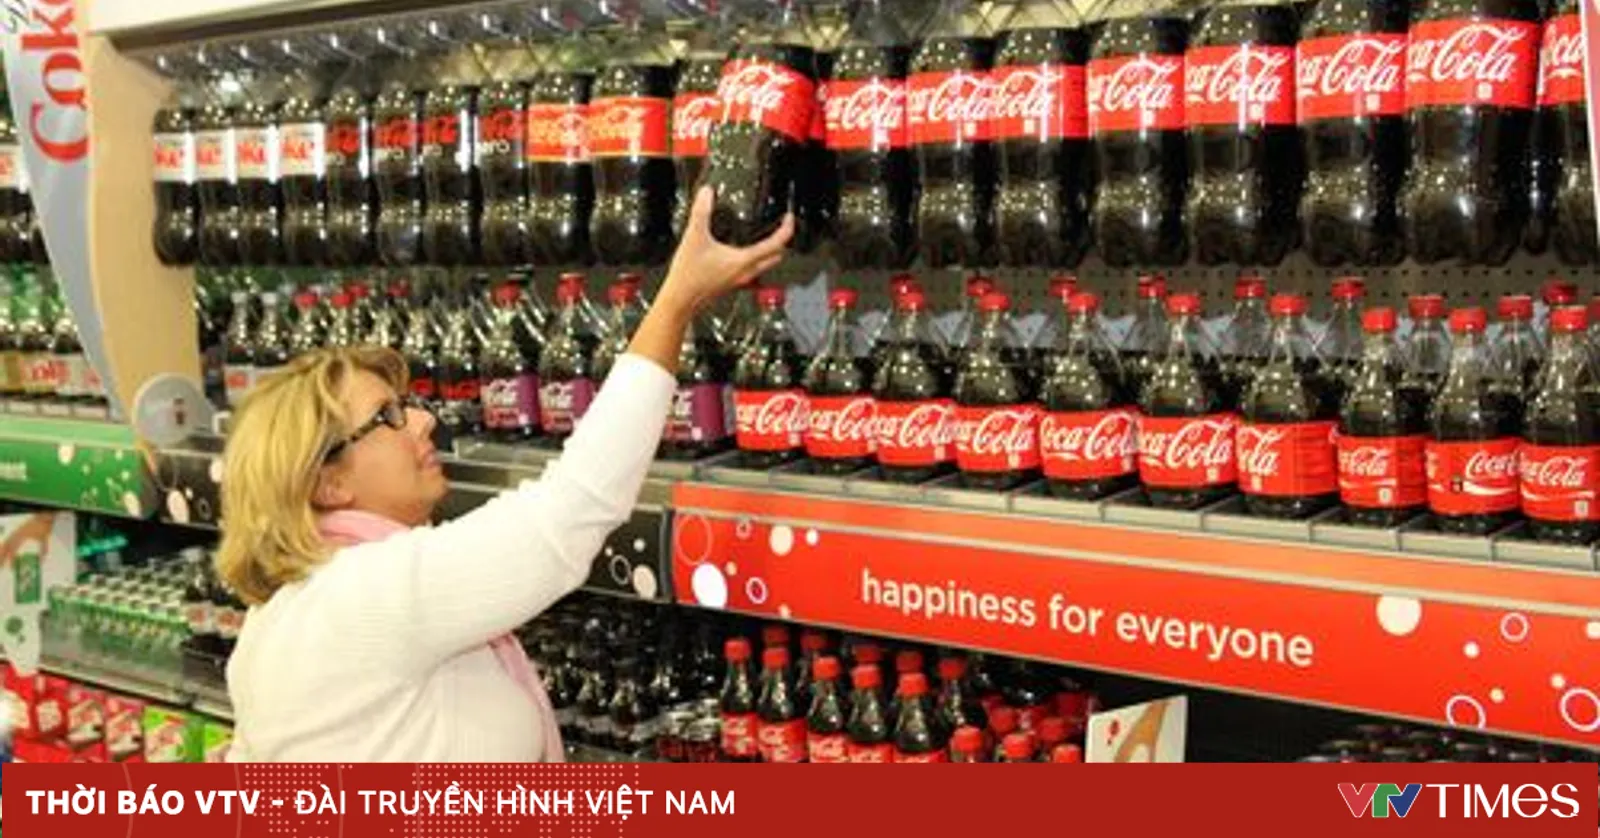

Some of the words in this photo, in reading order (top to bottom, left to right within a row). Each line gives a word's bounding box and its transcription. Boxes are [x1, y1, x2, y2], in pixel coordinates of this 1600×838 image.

[21, 0, 90, 163] Cok
[863, 568, 1036, 627] happiness
[1049, 593, 1103, 635] for
[1116, 612, 1313, 666] everyone
